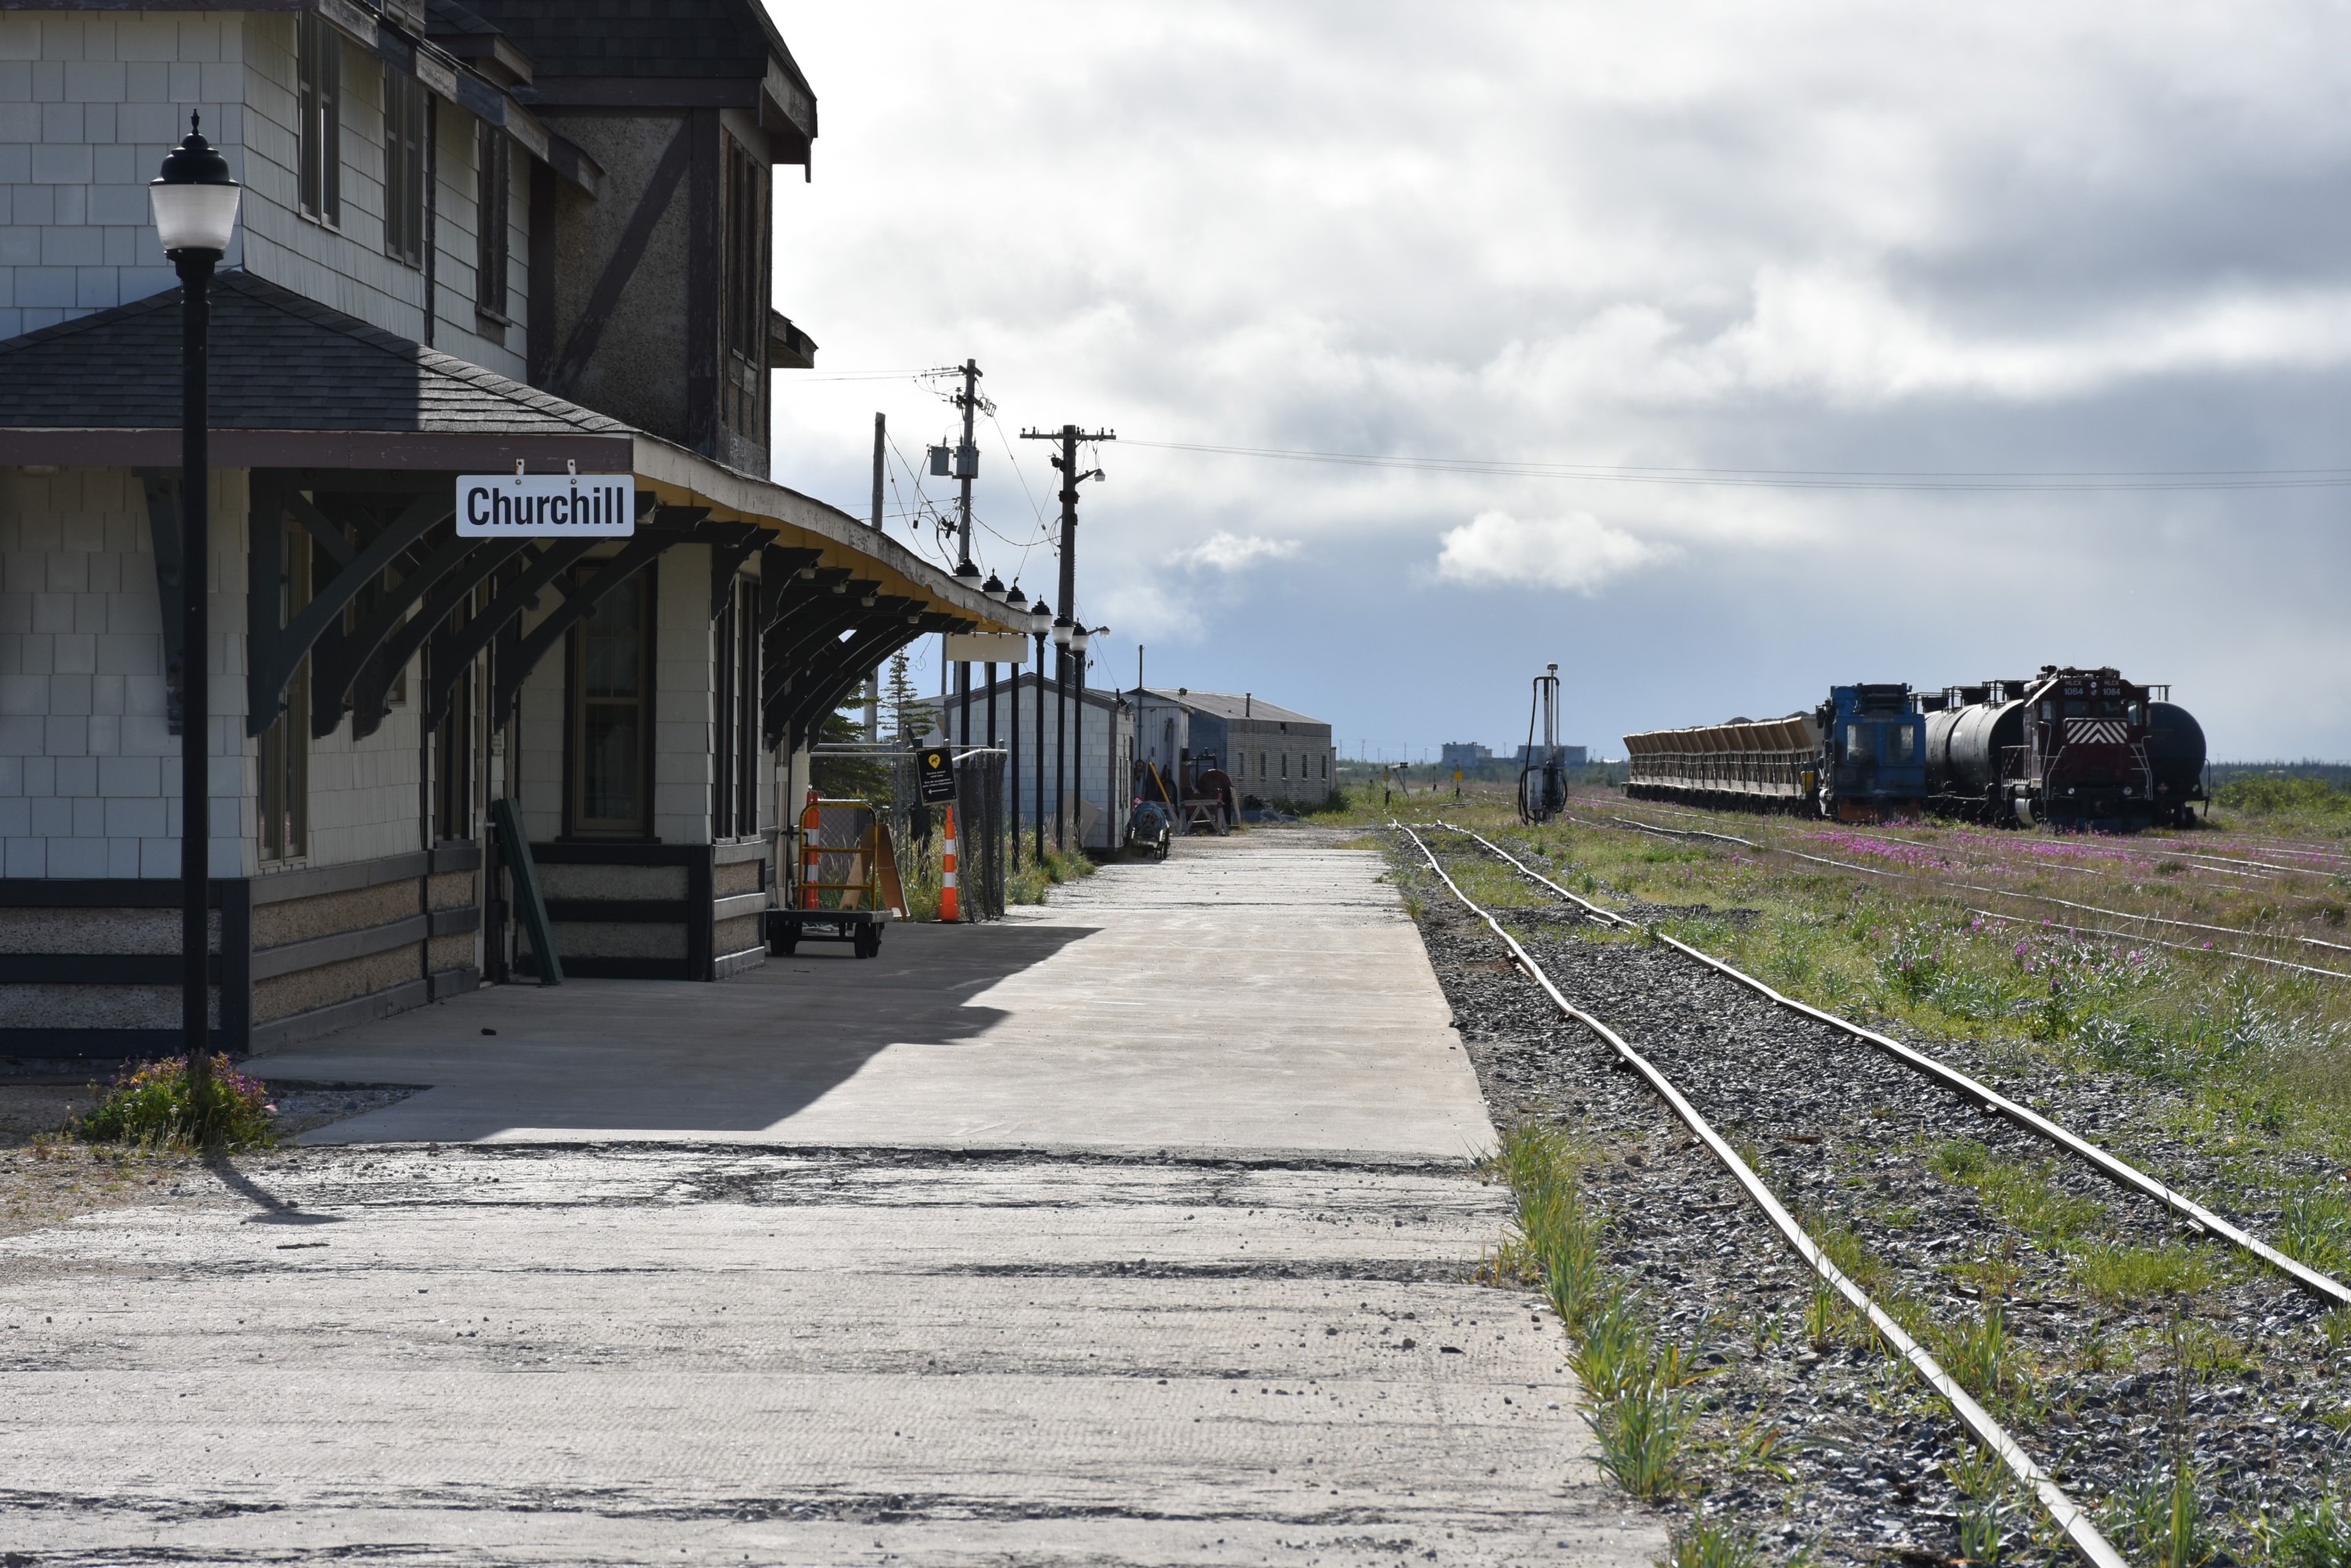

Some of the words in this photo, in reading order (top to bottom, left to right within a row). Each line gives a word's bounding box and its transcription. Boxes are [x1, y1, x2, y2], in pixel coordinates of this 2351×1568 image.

[467, 487, 624, 526] Churchill
[2063, 687, 2084, 696] 1084
[2102, 687, 2121, 696] 1084
